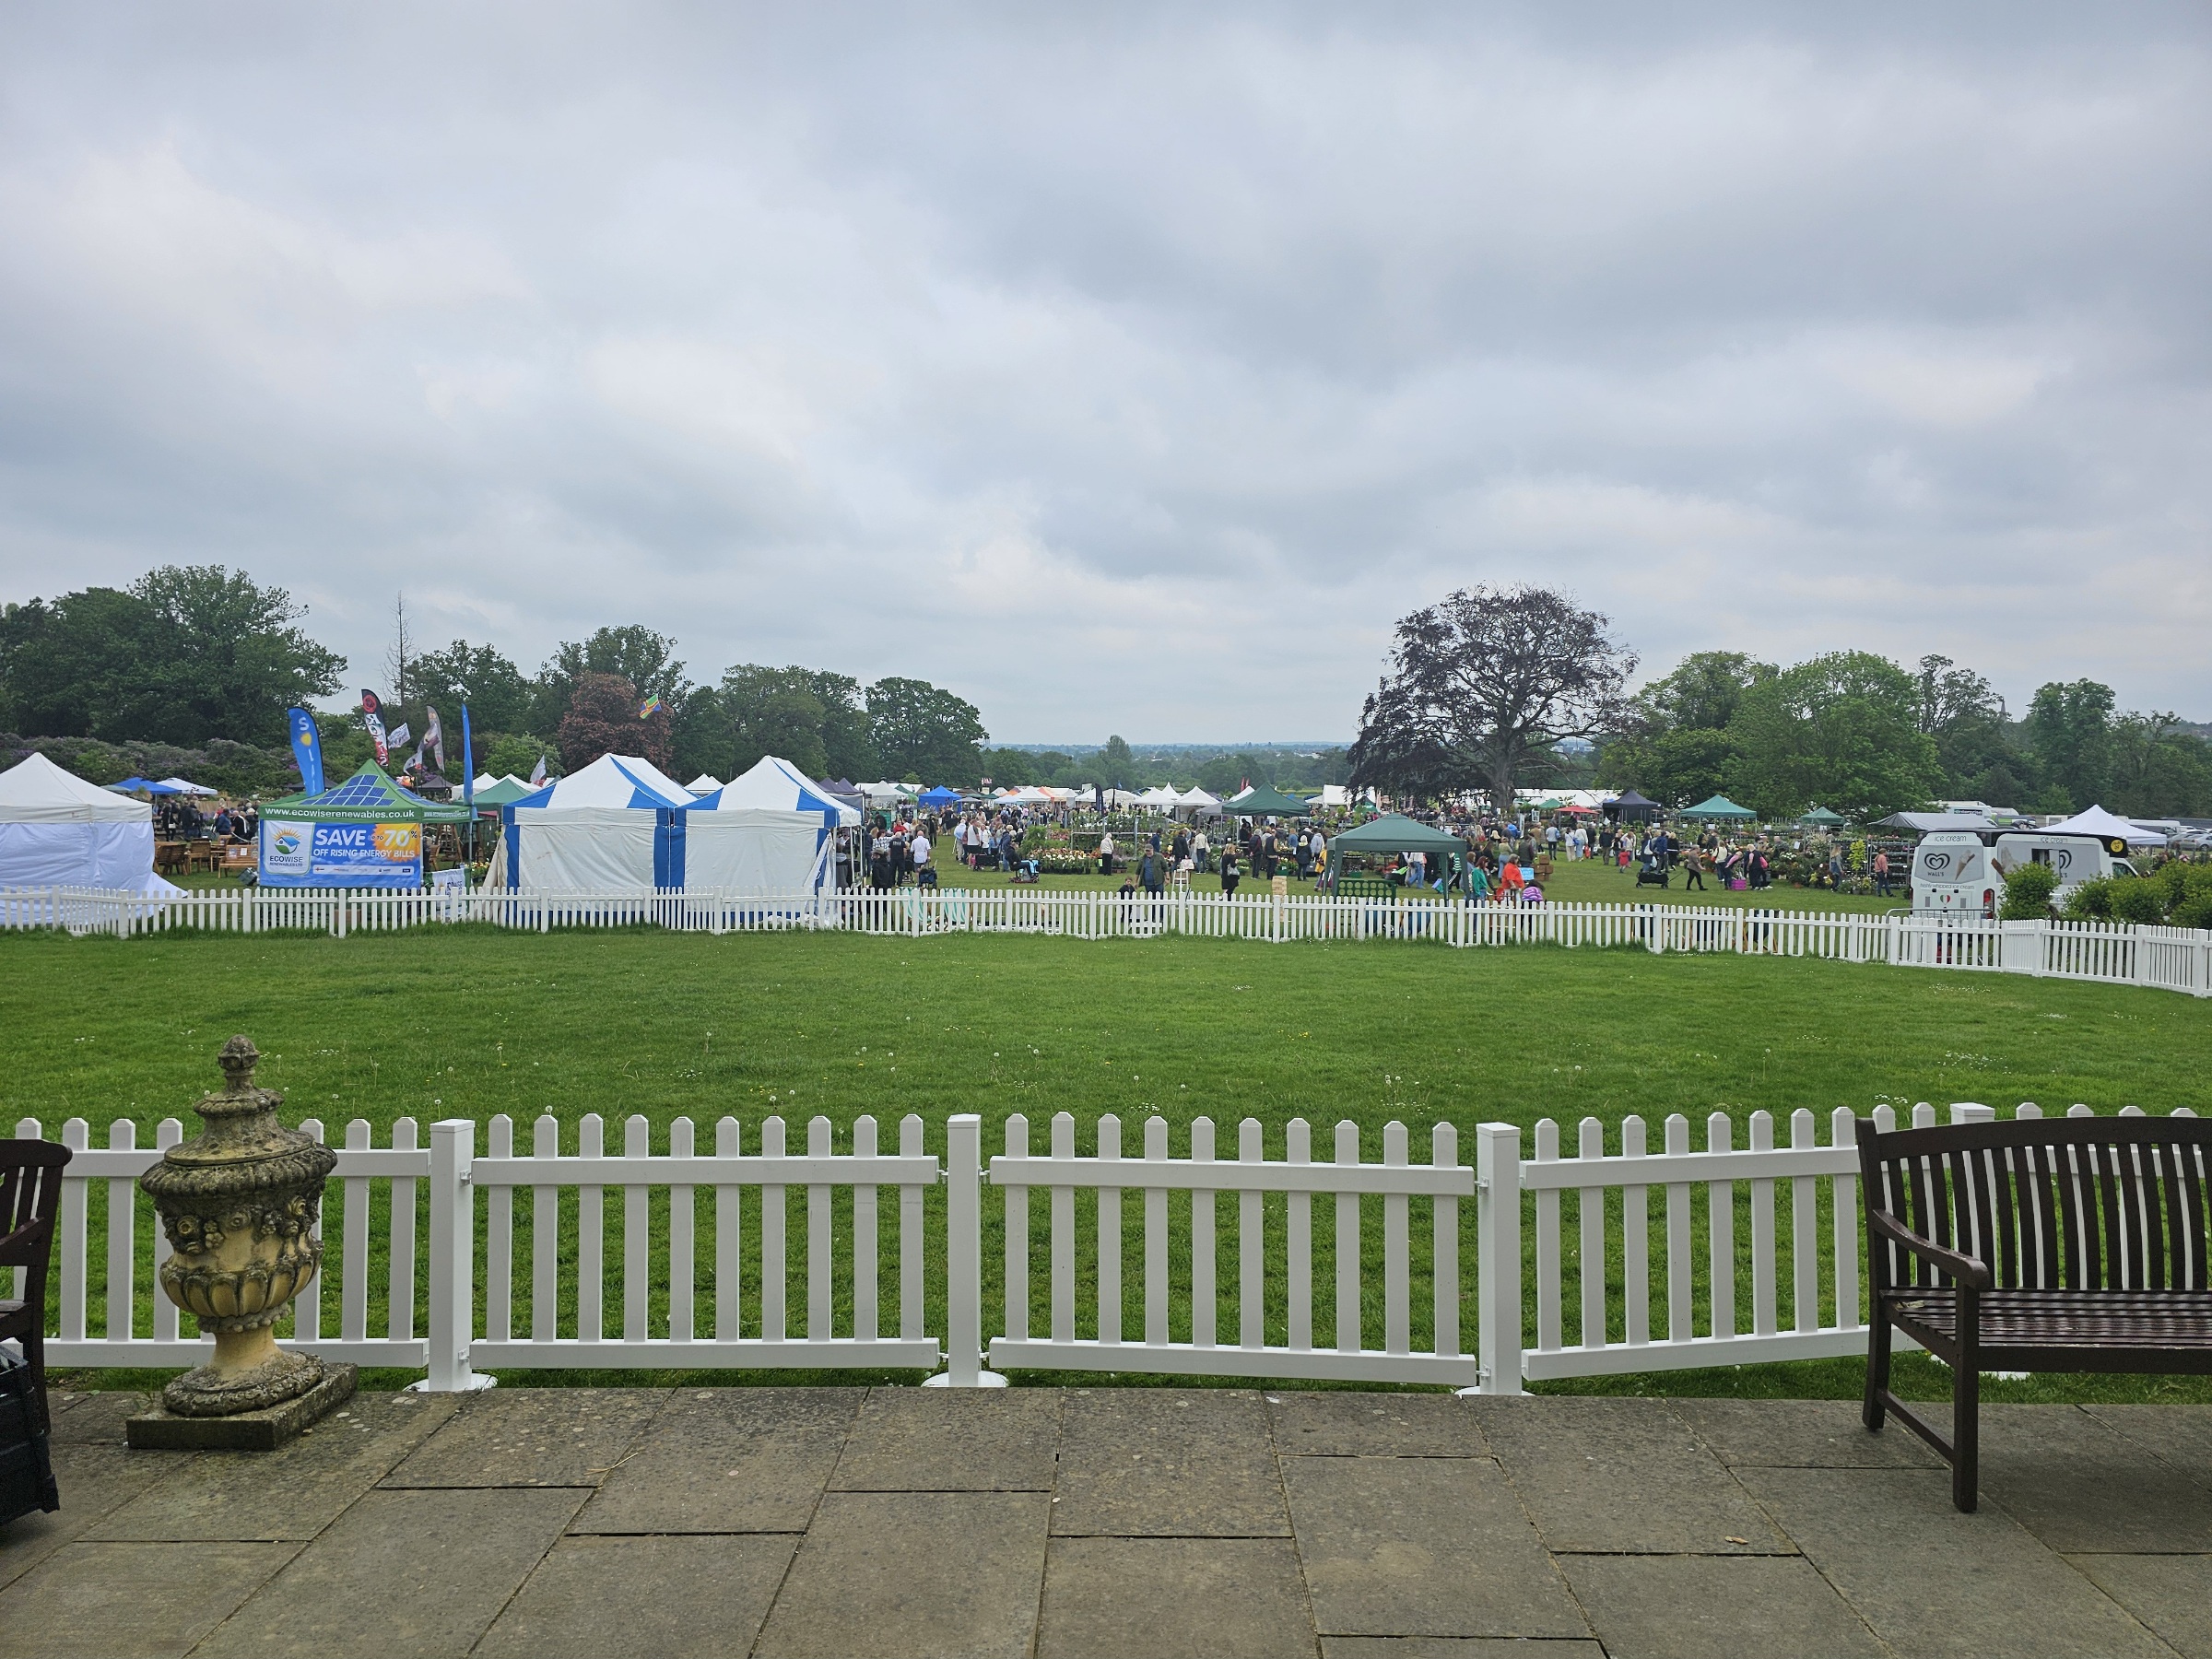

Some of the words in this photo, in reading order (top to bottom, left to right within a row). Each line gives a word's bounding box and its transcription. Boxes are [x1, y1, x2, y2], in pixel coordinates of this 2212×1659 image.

[265, 807, 416, 818] www.ecowiserenewables.co.uk
[315, 829, 367, 846] SAVE
[313, 849, 329, 857] OFF
[330, 849, 358, 857] RISING
[359, 850, 392, 858] ENERGY
[394, 850, 415, 858] BILLS
